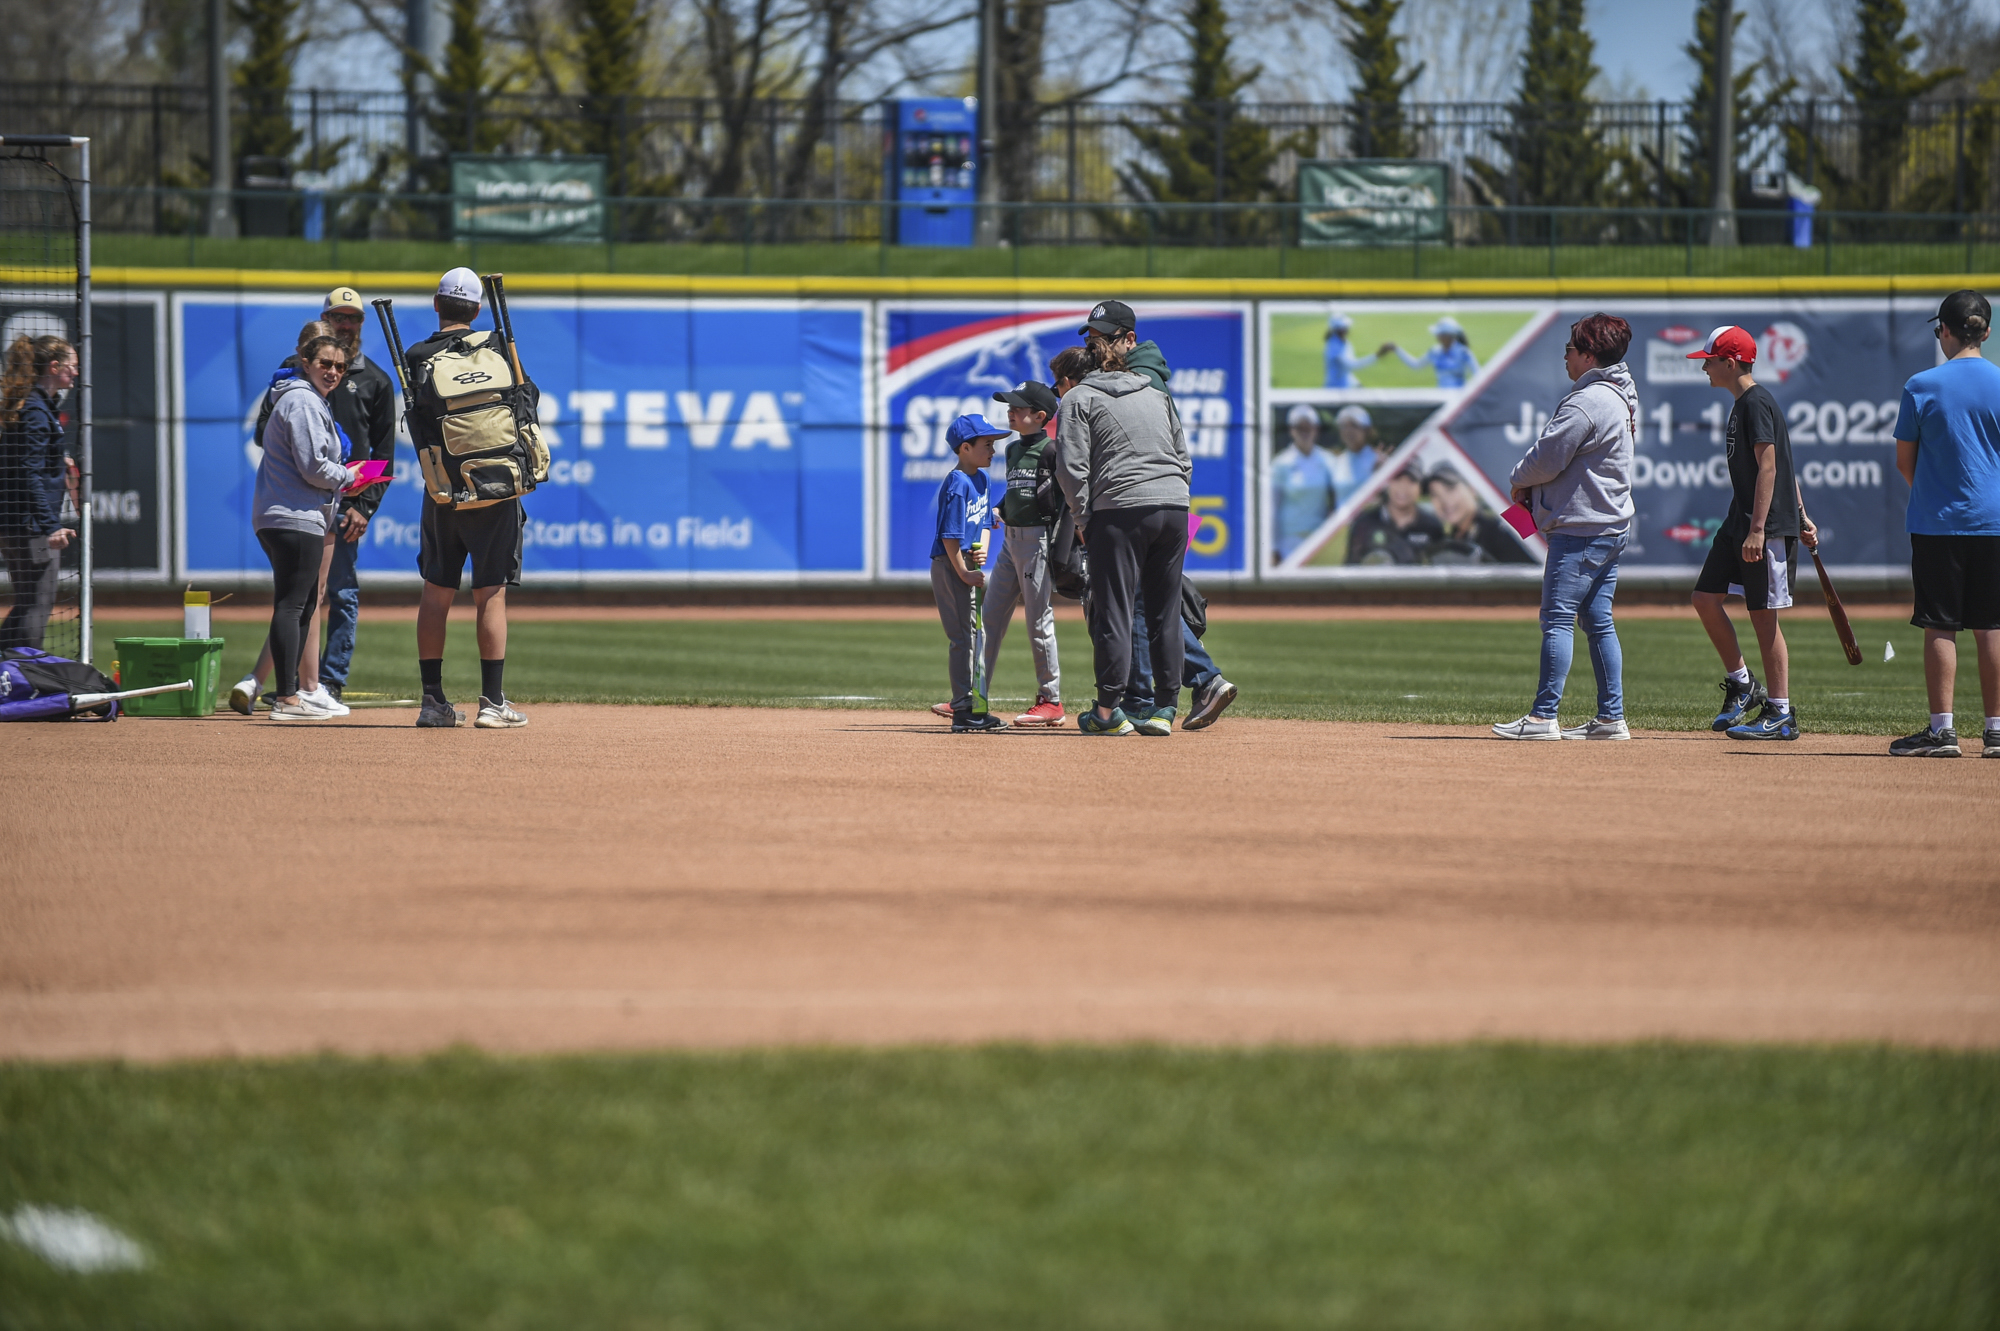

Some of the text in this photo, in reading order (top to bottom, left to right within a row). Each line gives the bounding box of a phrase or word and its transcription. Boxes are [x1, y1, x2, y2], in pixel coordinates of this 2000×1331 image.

[342, 291, 352, 301] C
[1787, 401, 1899, 444] 2022
[522, 516, 753, 548] Starts in a Field
